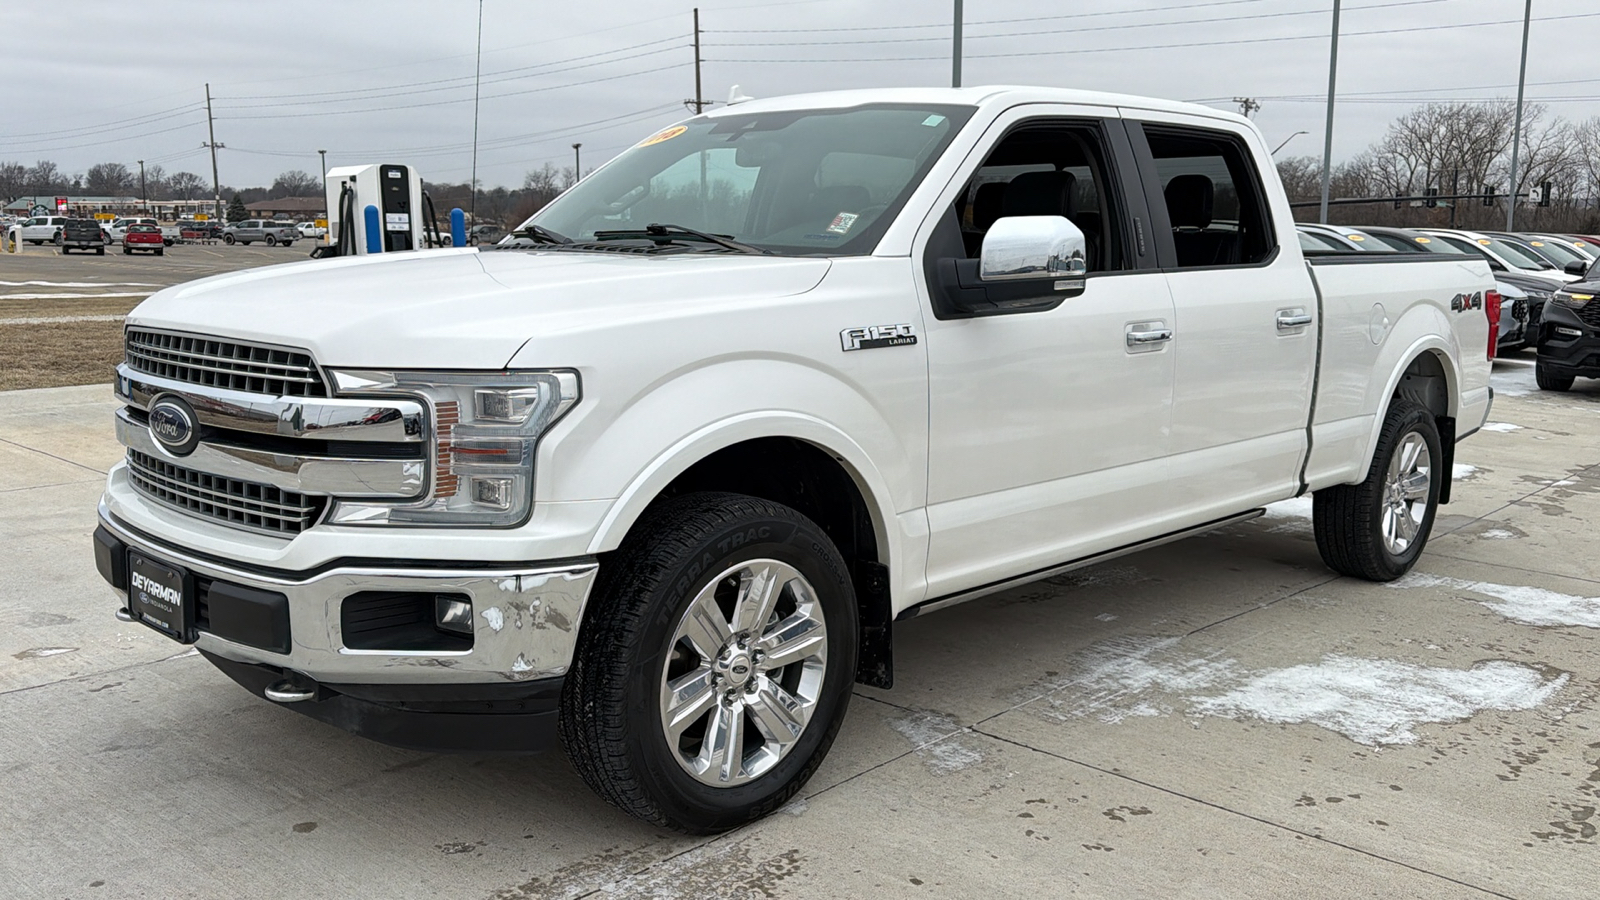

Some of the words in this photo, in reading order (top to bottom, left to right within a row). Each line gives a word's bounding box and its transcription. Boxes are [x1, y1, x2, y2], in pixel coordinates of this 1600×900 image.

[889, 337, 915, 345] LARIAT
[154, 410, 179, 437] Ford
[131, 571, 181, 606] DEYARMAN
[656, 551, 715, 627] TERRA
[717, 526, 772, 553] TRAC
